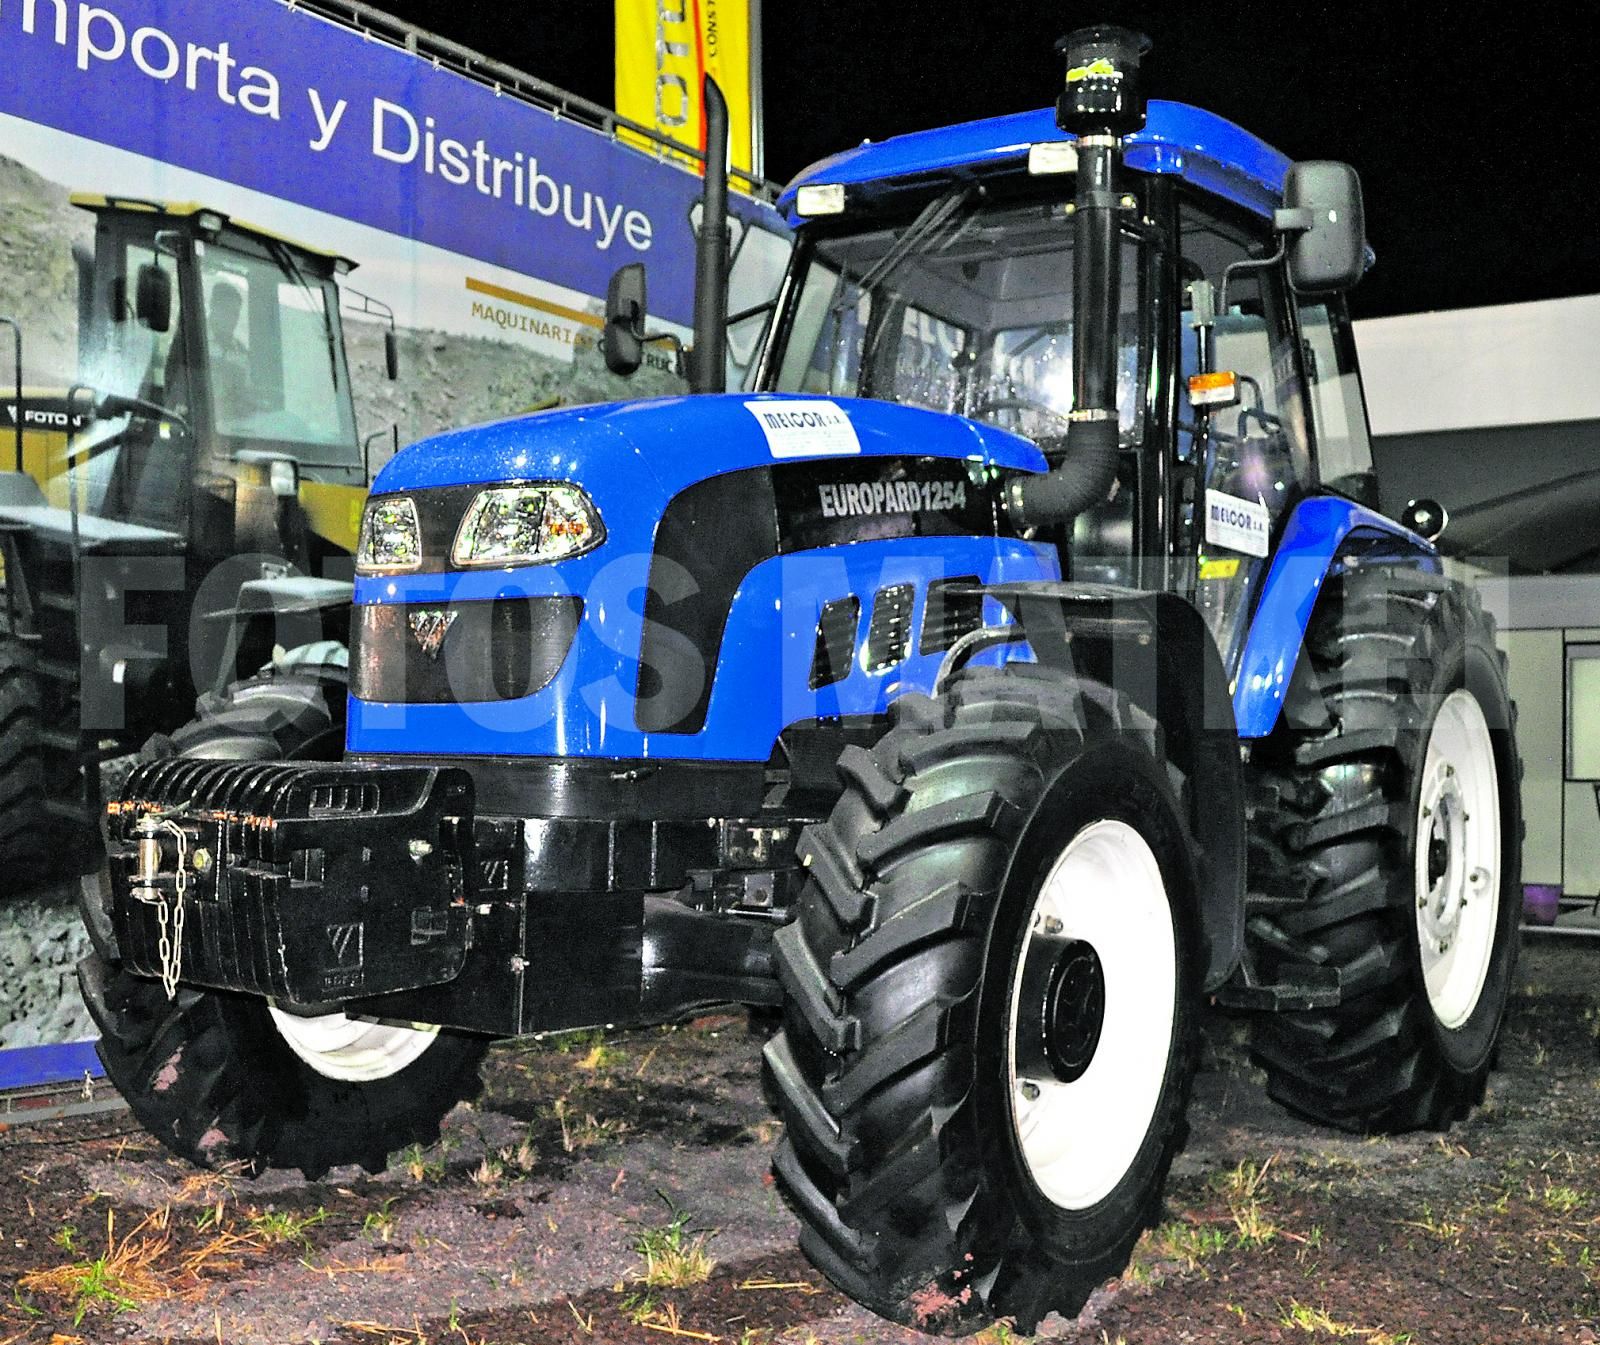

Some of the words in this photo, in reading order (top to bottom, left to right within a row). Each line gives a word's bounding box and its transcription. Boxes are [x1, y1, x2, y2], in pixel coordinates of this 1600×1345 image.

[308, 88, 347, 151] y
[372, 97, 653, 251] Distribuye
[1211, 504, 1252, 531] MELCOR
